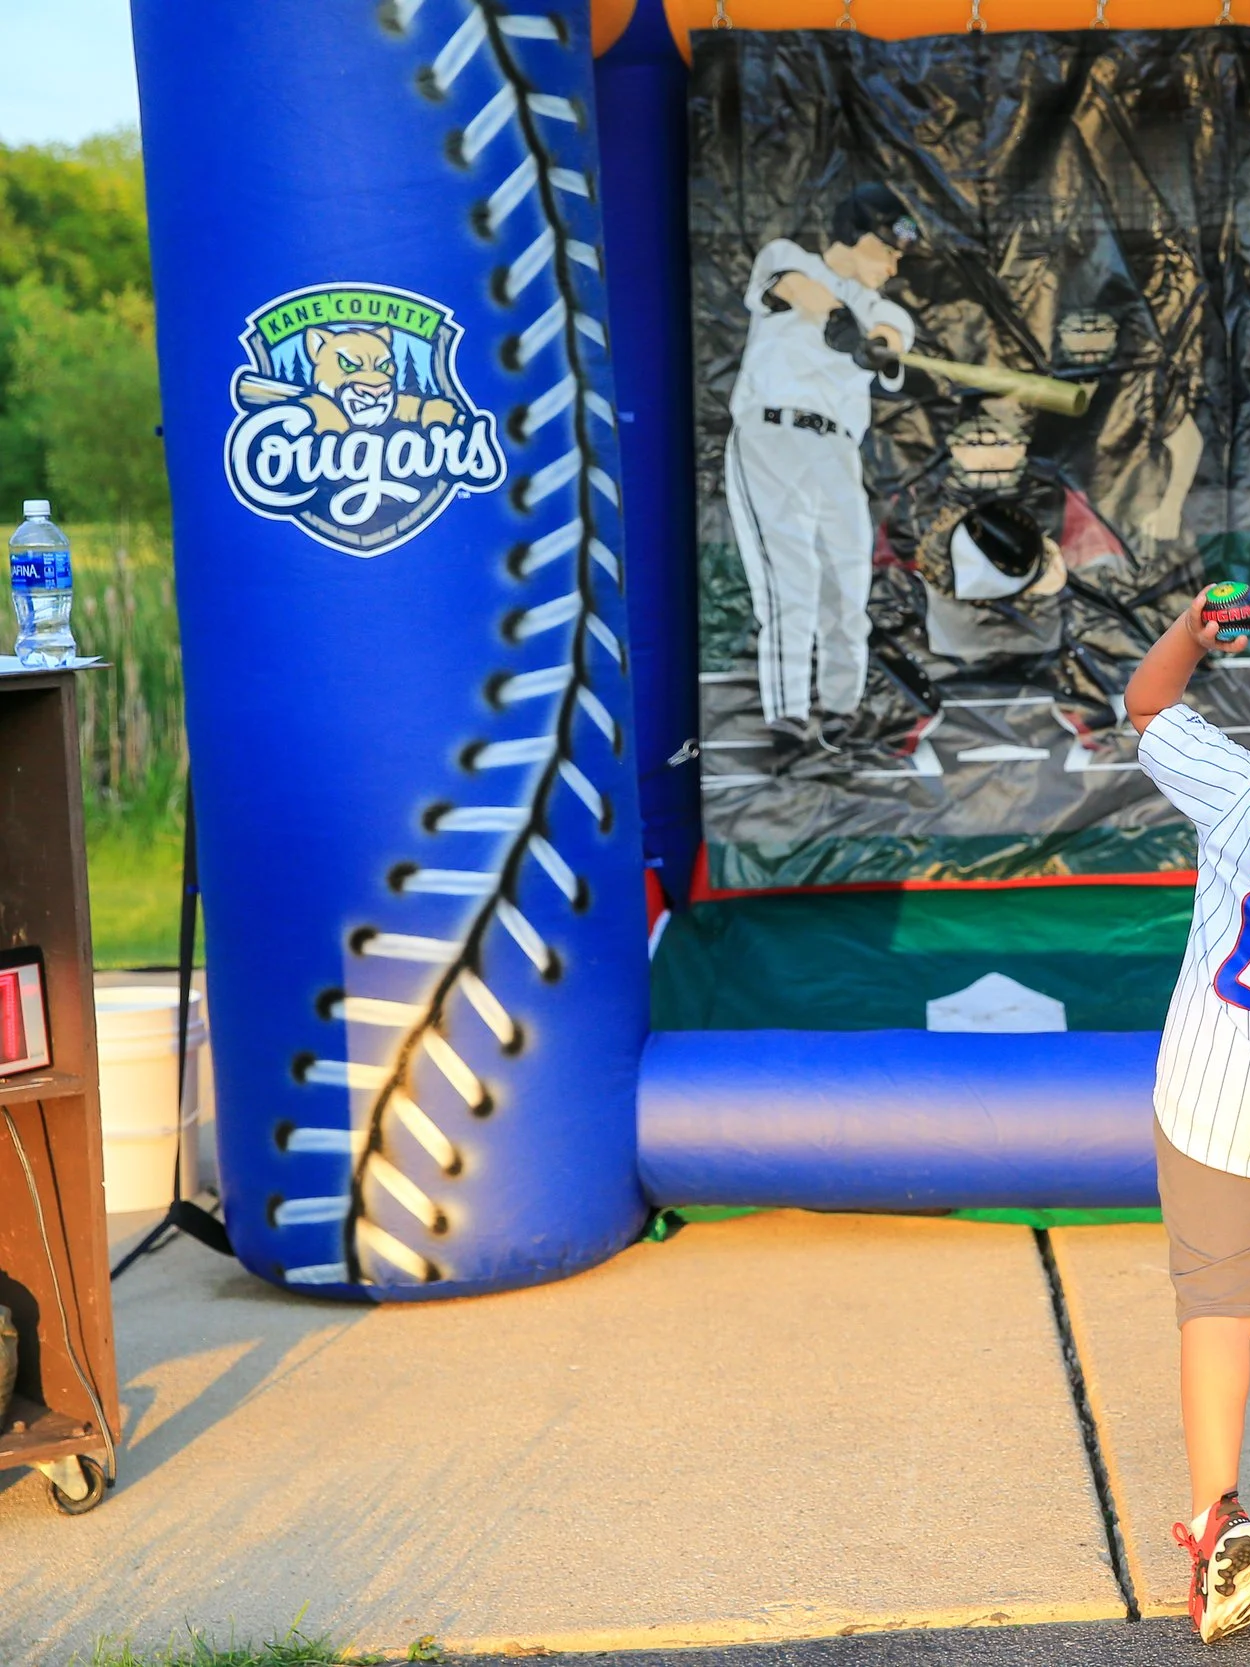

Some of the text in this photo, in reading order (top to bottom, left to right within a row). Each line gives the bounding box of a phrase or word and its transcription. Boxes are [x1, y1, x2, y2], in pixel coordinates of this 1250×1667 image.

[268, 299, 431, 336] KANE COUNTY
[231, 404, 498, 526] Cougars
